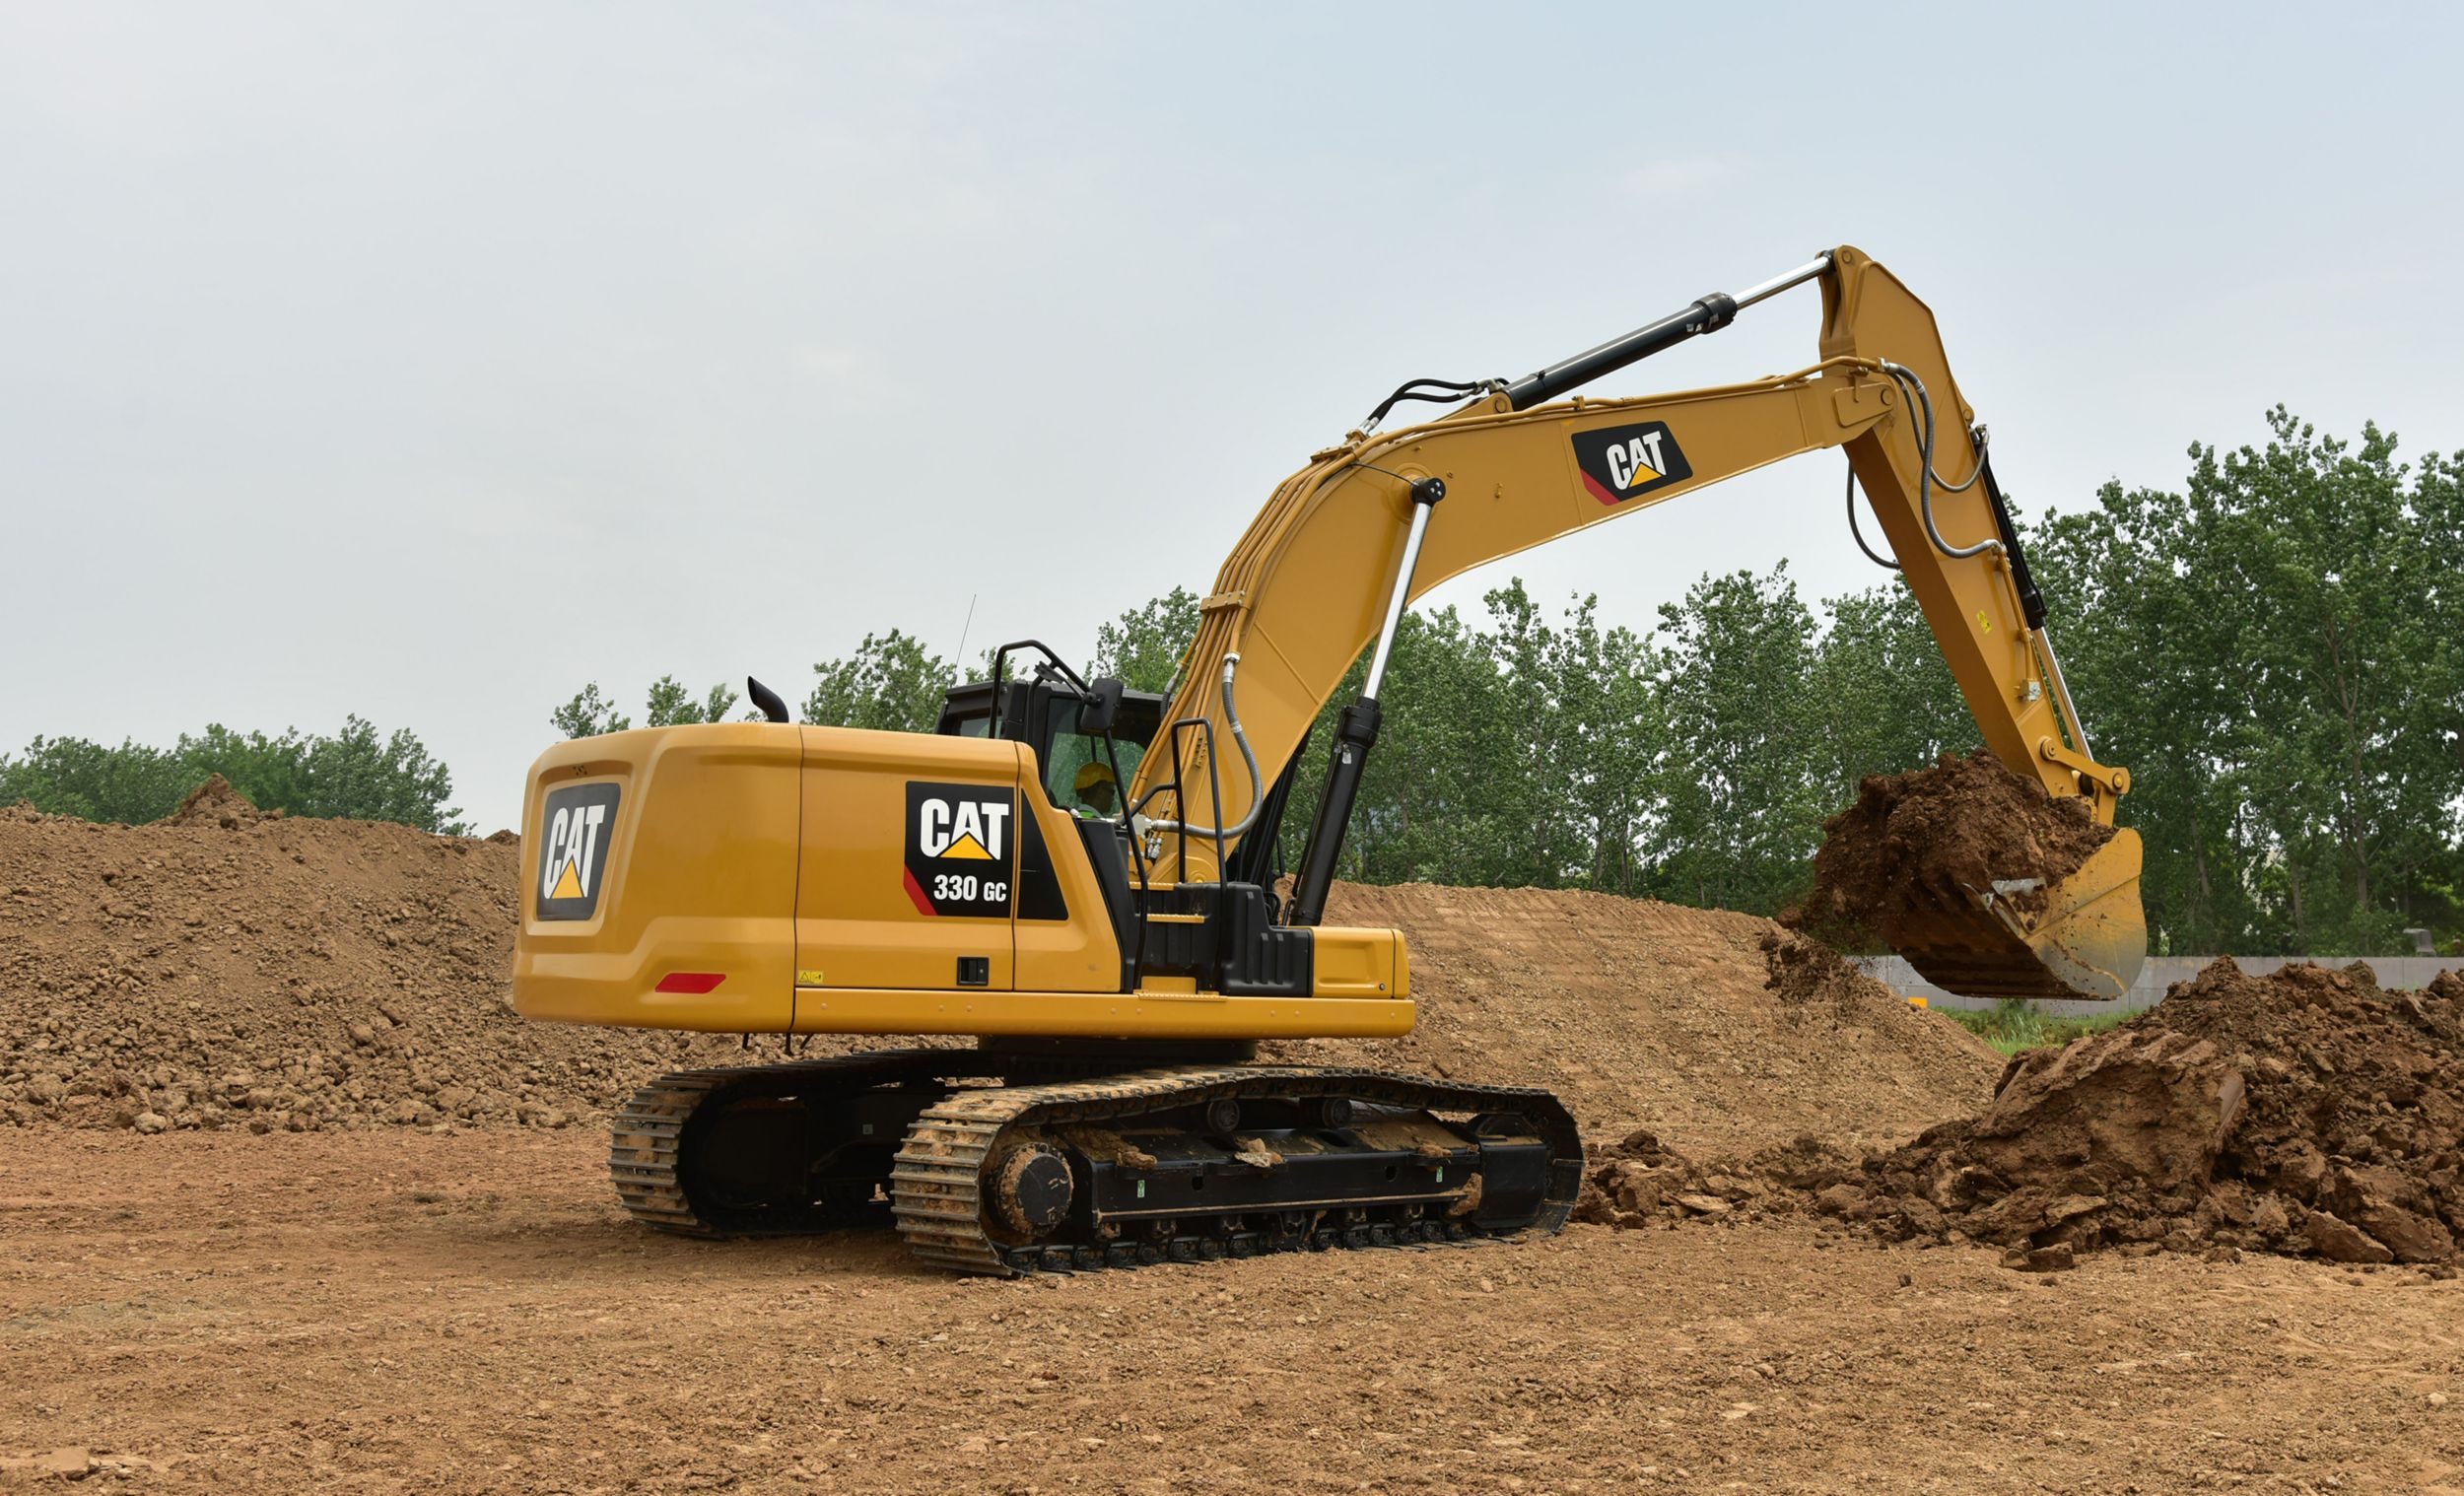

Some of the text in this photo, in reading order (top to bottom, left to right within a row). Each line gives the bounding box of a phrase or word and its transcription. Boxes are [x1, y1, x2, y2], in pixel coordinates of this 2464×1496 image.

[1607, 430, 1667, 490] CAT
[543, 804, 606, 900] CAT
[921, 798, 1009, 860] CAT
[933, 874, 1007, 902] 330 GC
